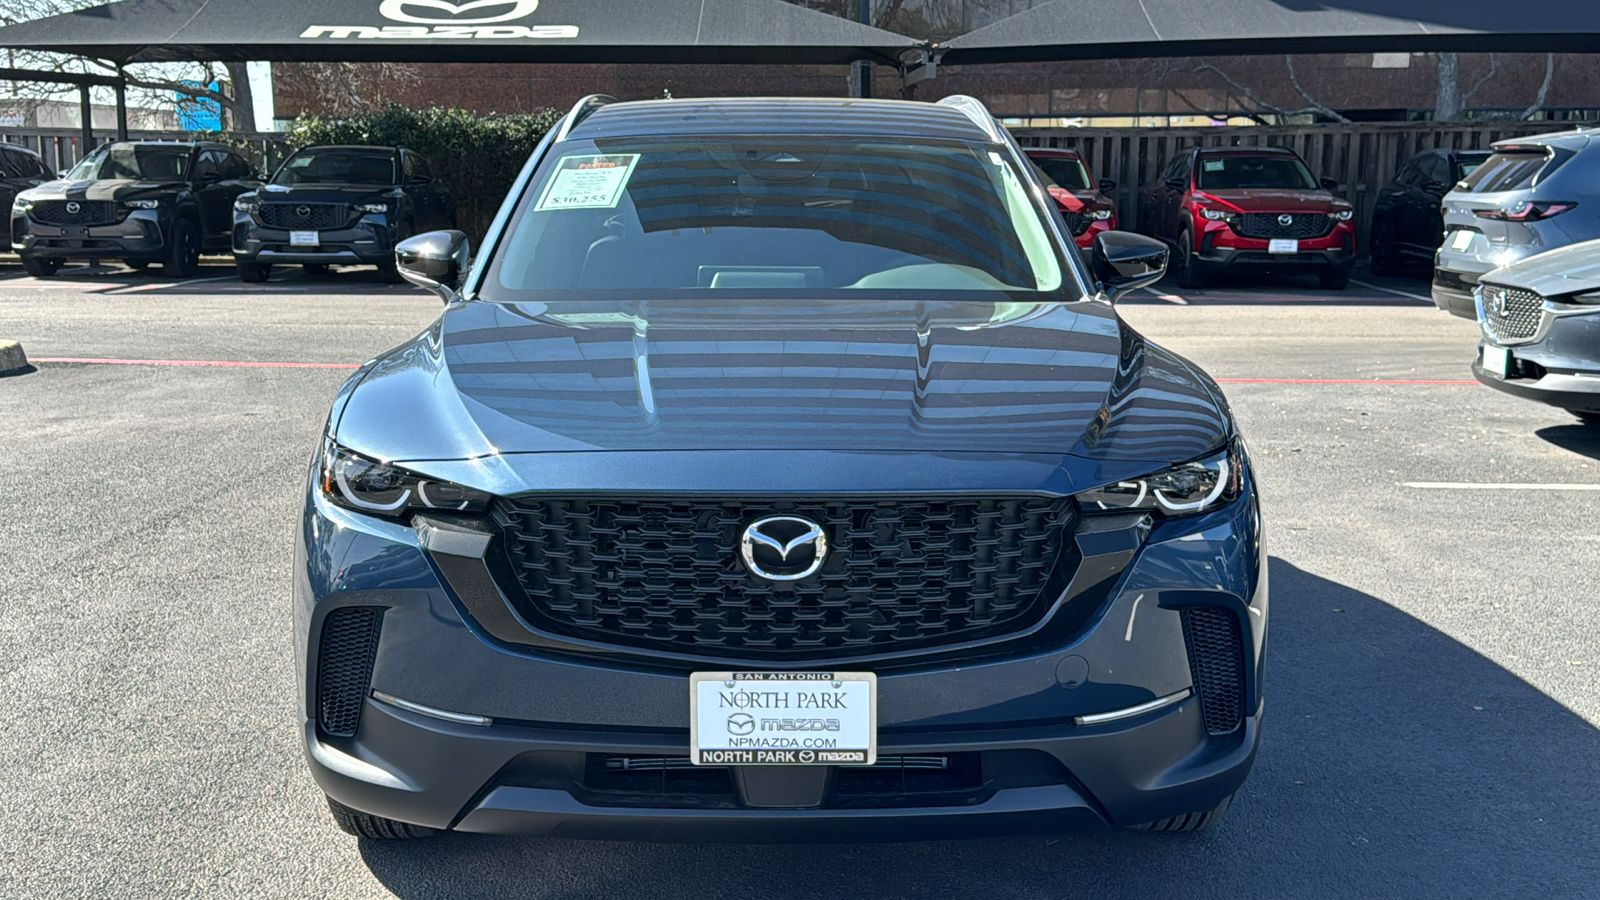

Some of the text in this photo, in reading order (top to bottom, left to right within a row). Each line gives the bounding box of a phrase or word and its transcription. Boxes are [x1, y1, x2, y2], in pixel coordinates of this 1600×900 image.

[299, 25, 580, 39] mazda
[578, 162, 616, 170] POSTED
[718, 690, 848, 710] NORTH PARK
[760, 718, 840, 731] mazda
[728, 737, 837, 748] NPMAZDA.COM
[702, 751, 864, 762] NORTH PARK mazda
